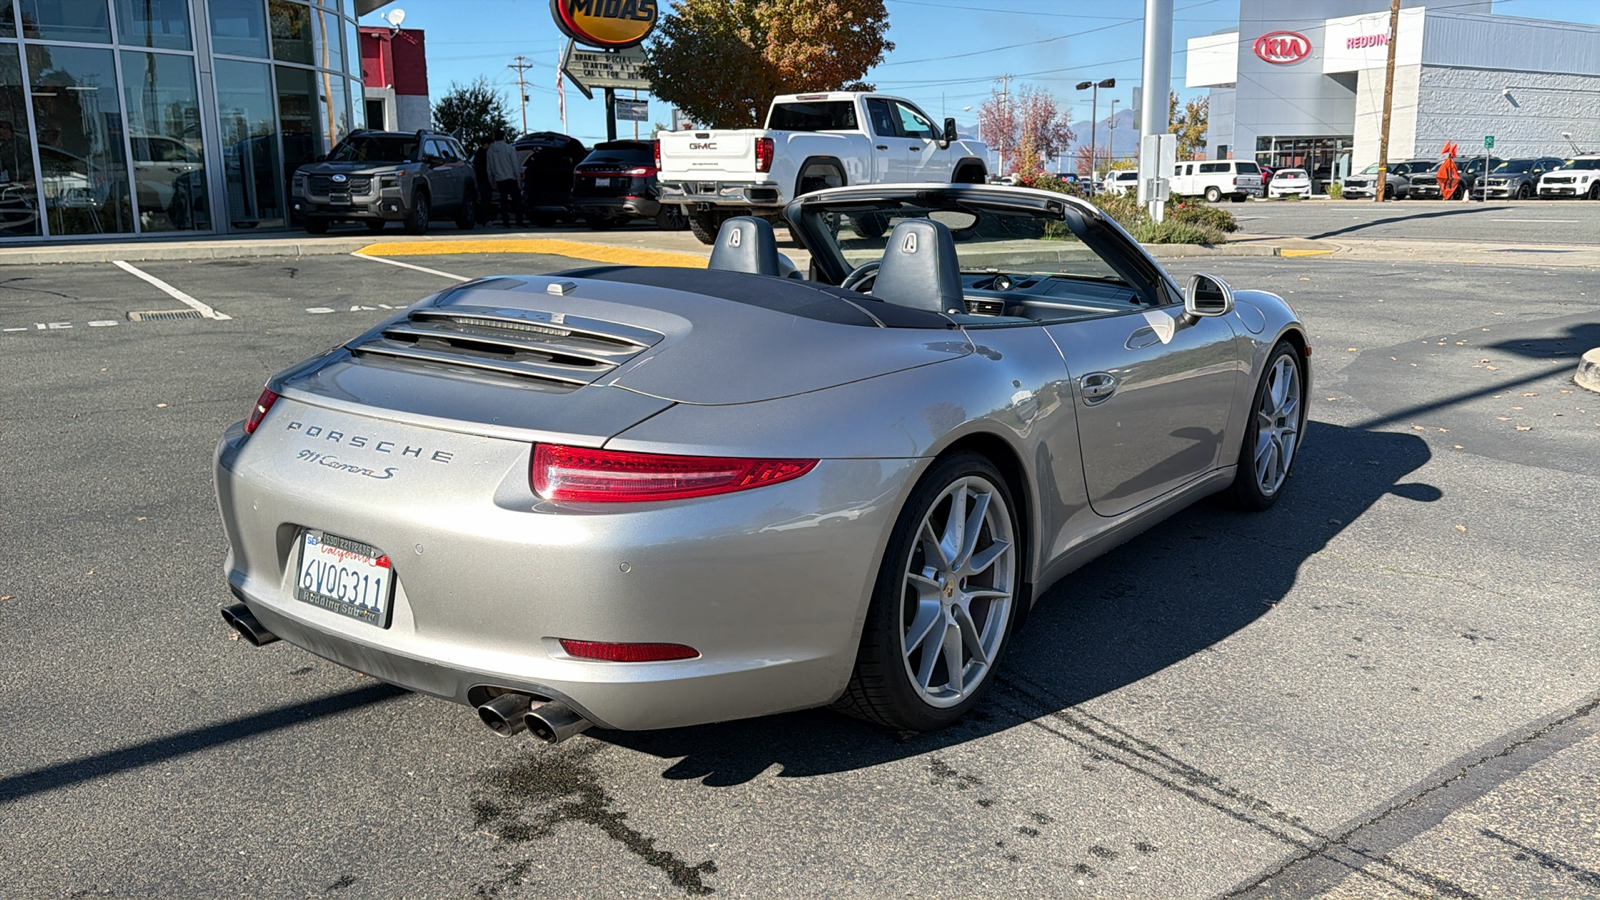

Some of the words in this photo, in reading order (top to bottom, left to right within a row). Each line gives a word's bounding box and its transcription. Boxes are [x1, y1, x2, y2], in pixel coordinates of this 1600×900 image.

[569, 0, 655, 21] MIDAS
[1263, 38, 1303, 58] KIA
[1346, 33, 1389, 49] REDDIN
[582, 62, 614, 70] STARTING
[689, 142, 718, 150] GMC
[286, 421, 454, 464] PORSCHE
[319, 455, 375, 478] Carrera
